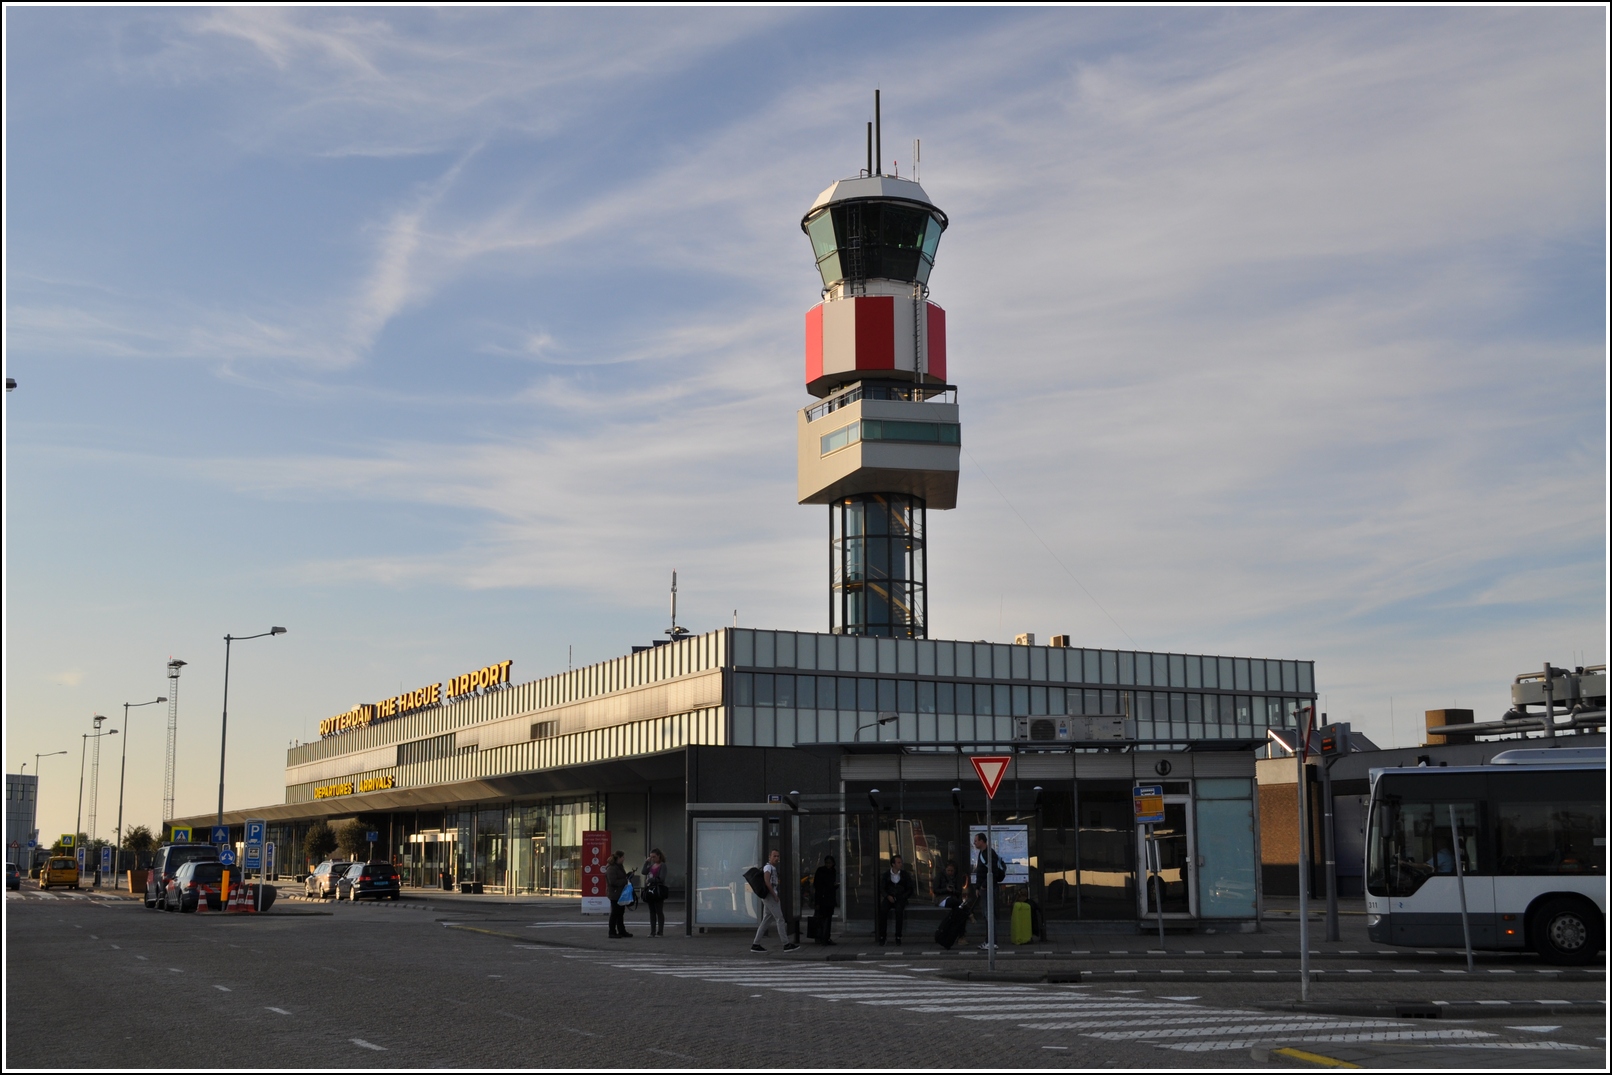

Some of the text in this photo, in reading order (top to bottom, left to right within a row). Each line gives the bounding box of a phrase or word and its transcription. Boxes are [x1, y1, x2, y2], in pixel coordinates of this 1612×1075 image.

[319, 660, 512, 735] ROTTERDAM THE HAGUE AIRPORT
[314, 775, 393, 799] DEPARTURES ARRIVALS
[251, 825, 260, 837] P
[1368, 901, 1378, 909] 311
